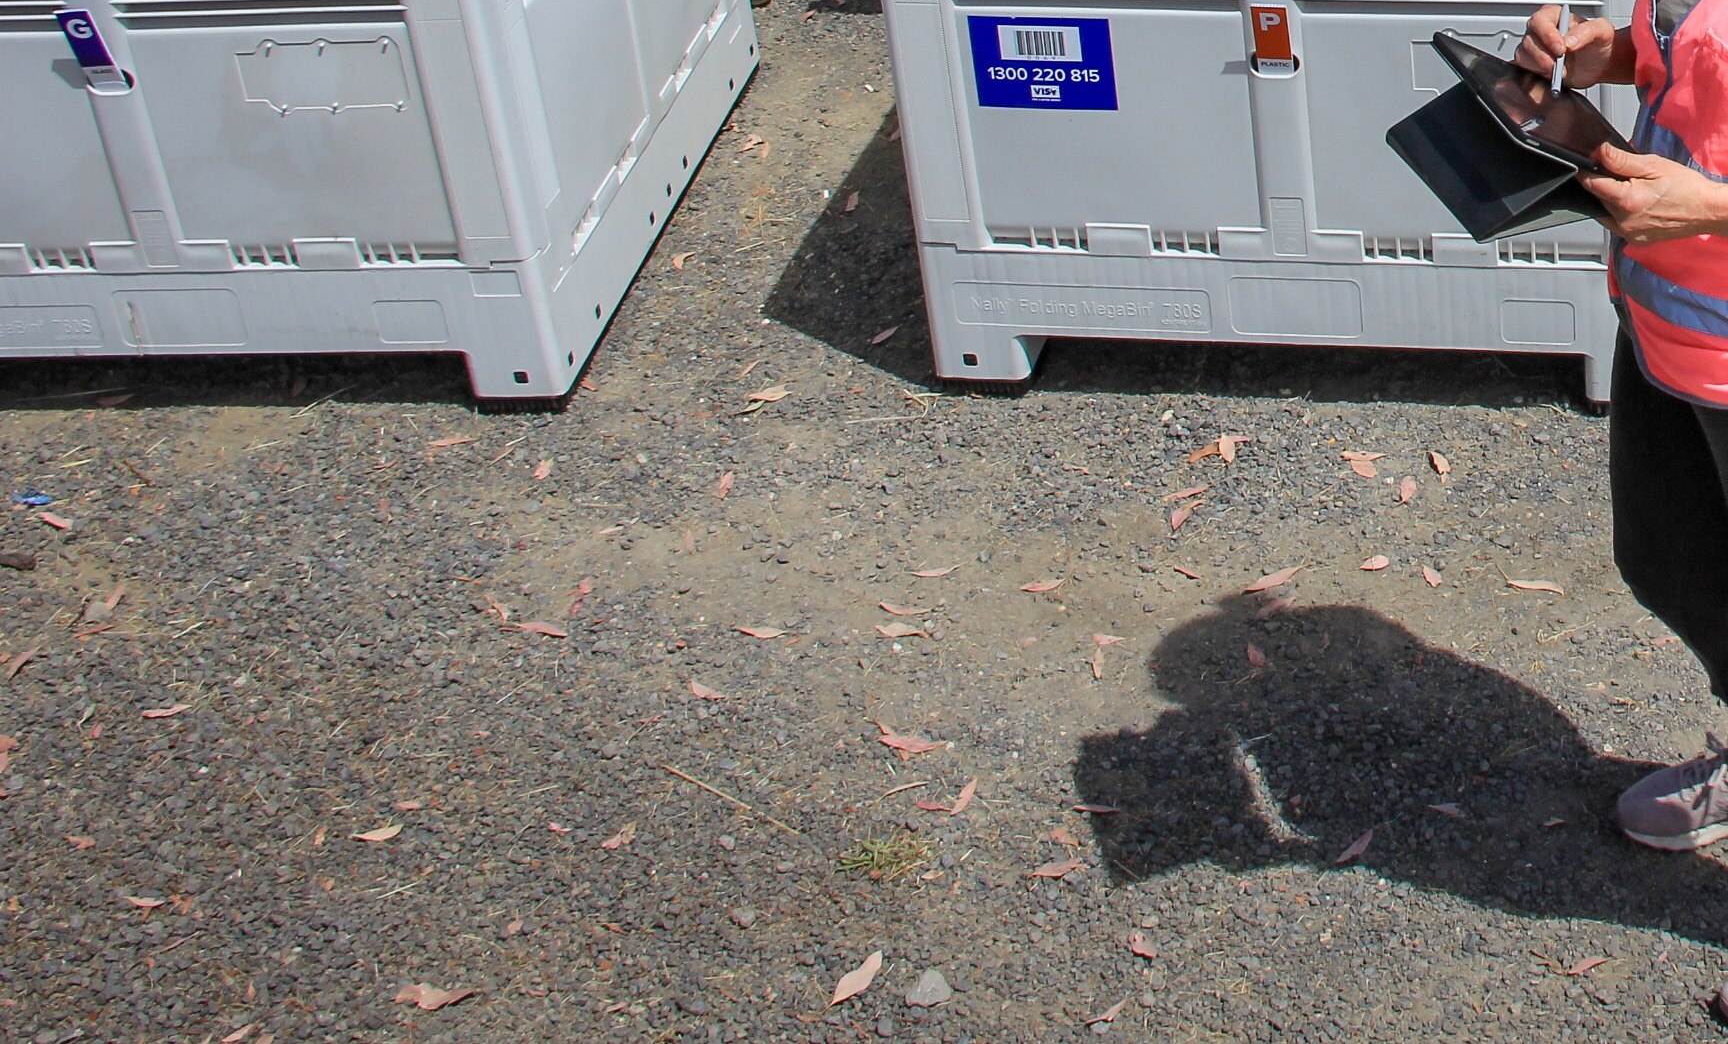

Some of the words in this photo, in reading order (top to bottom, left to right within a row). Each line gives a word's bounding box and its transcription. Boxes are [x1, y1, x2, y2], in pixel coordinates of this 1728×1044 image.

[66, 18, 94, 39] G
[1259, 12, 1281, 31] P
[987, 66, 1028, 81] 1300
[1032, 68, 1066, 82] 220
[1070, 69, 1100, 83] 815
[1033, 87, 1057, 96] VISY
[970, 296, 1008, 314] Nally
[1019, 298, 1076, 318] Folding
[1082, 301, 1150, 319] MegaBin
